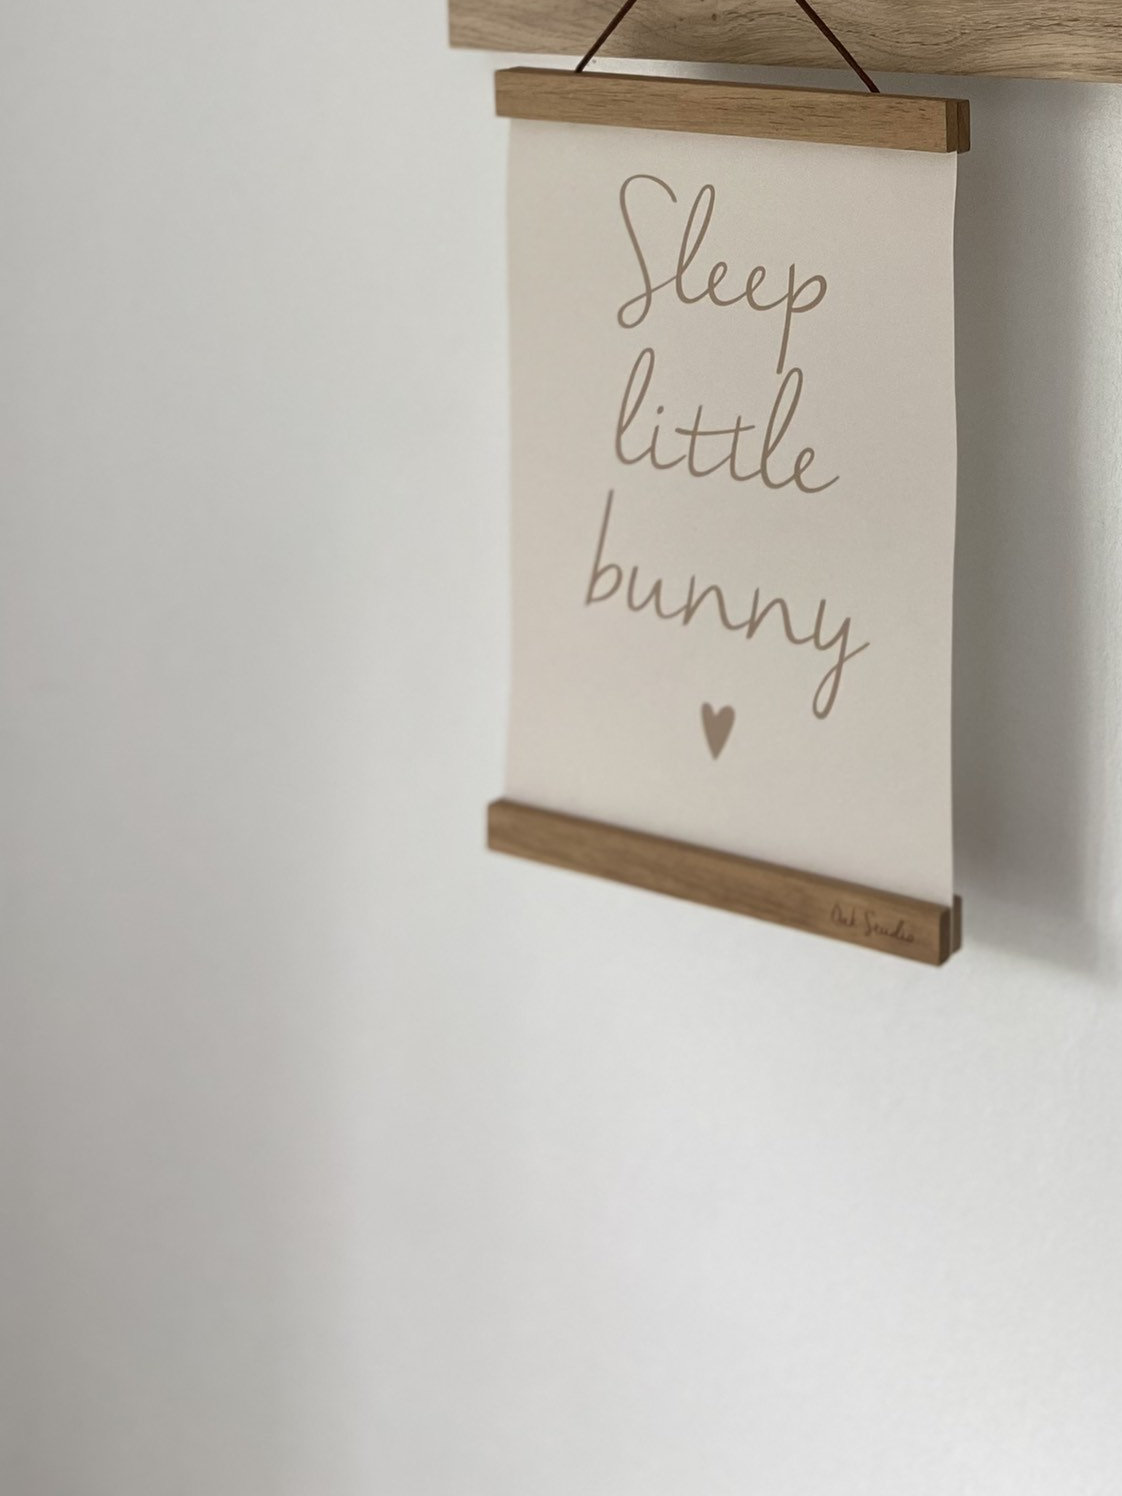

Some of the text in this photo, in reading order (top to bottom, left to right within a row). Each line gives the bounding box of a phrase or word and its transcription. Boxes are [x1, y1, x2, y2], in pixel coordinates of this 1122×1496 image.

[617, 174, 828, 374] Sleep
[614, 347, 840, 494] little
[584, 488, 871, 720] bunny
[863, 910, 915, 944] Studio
